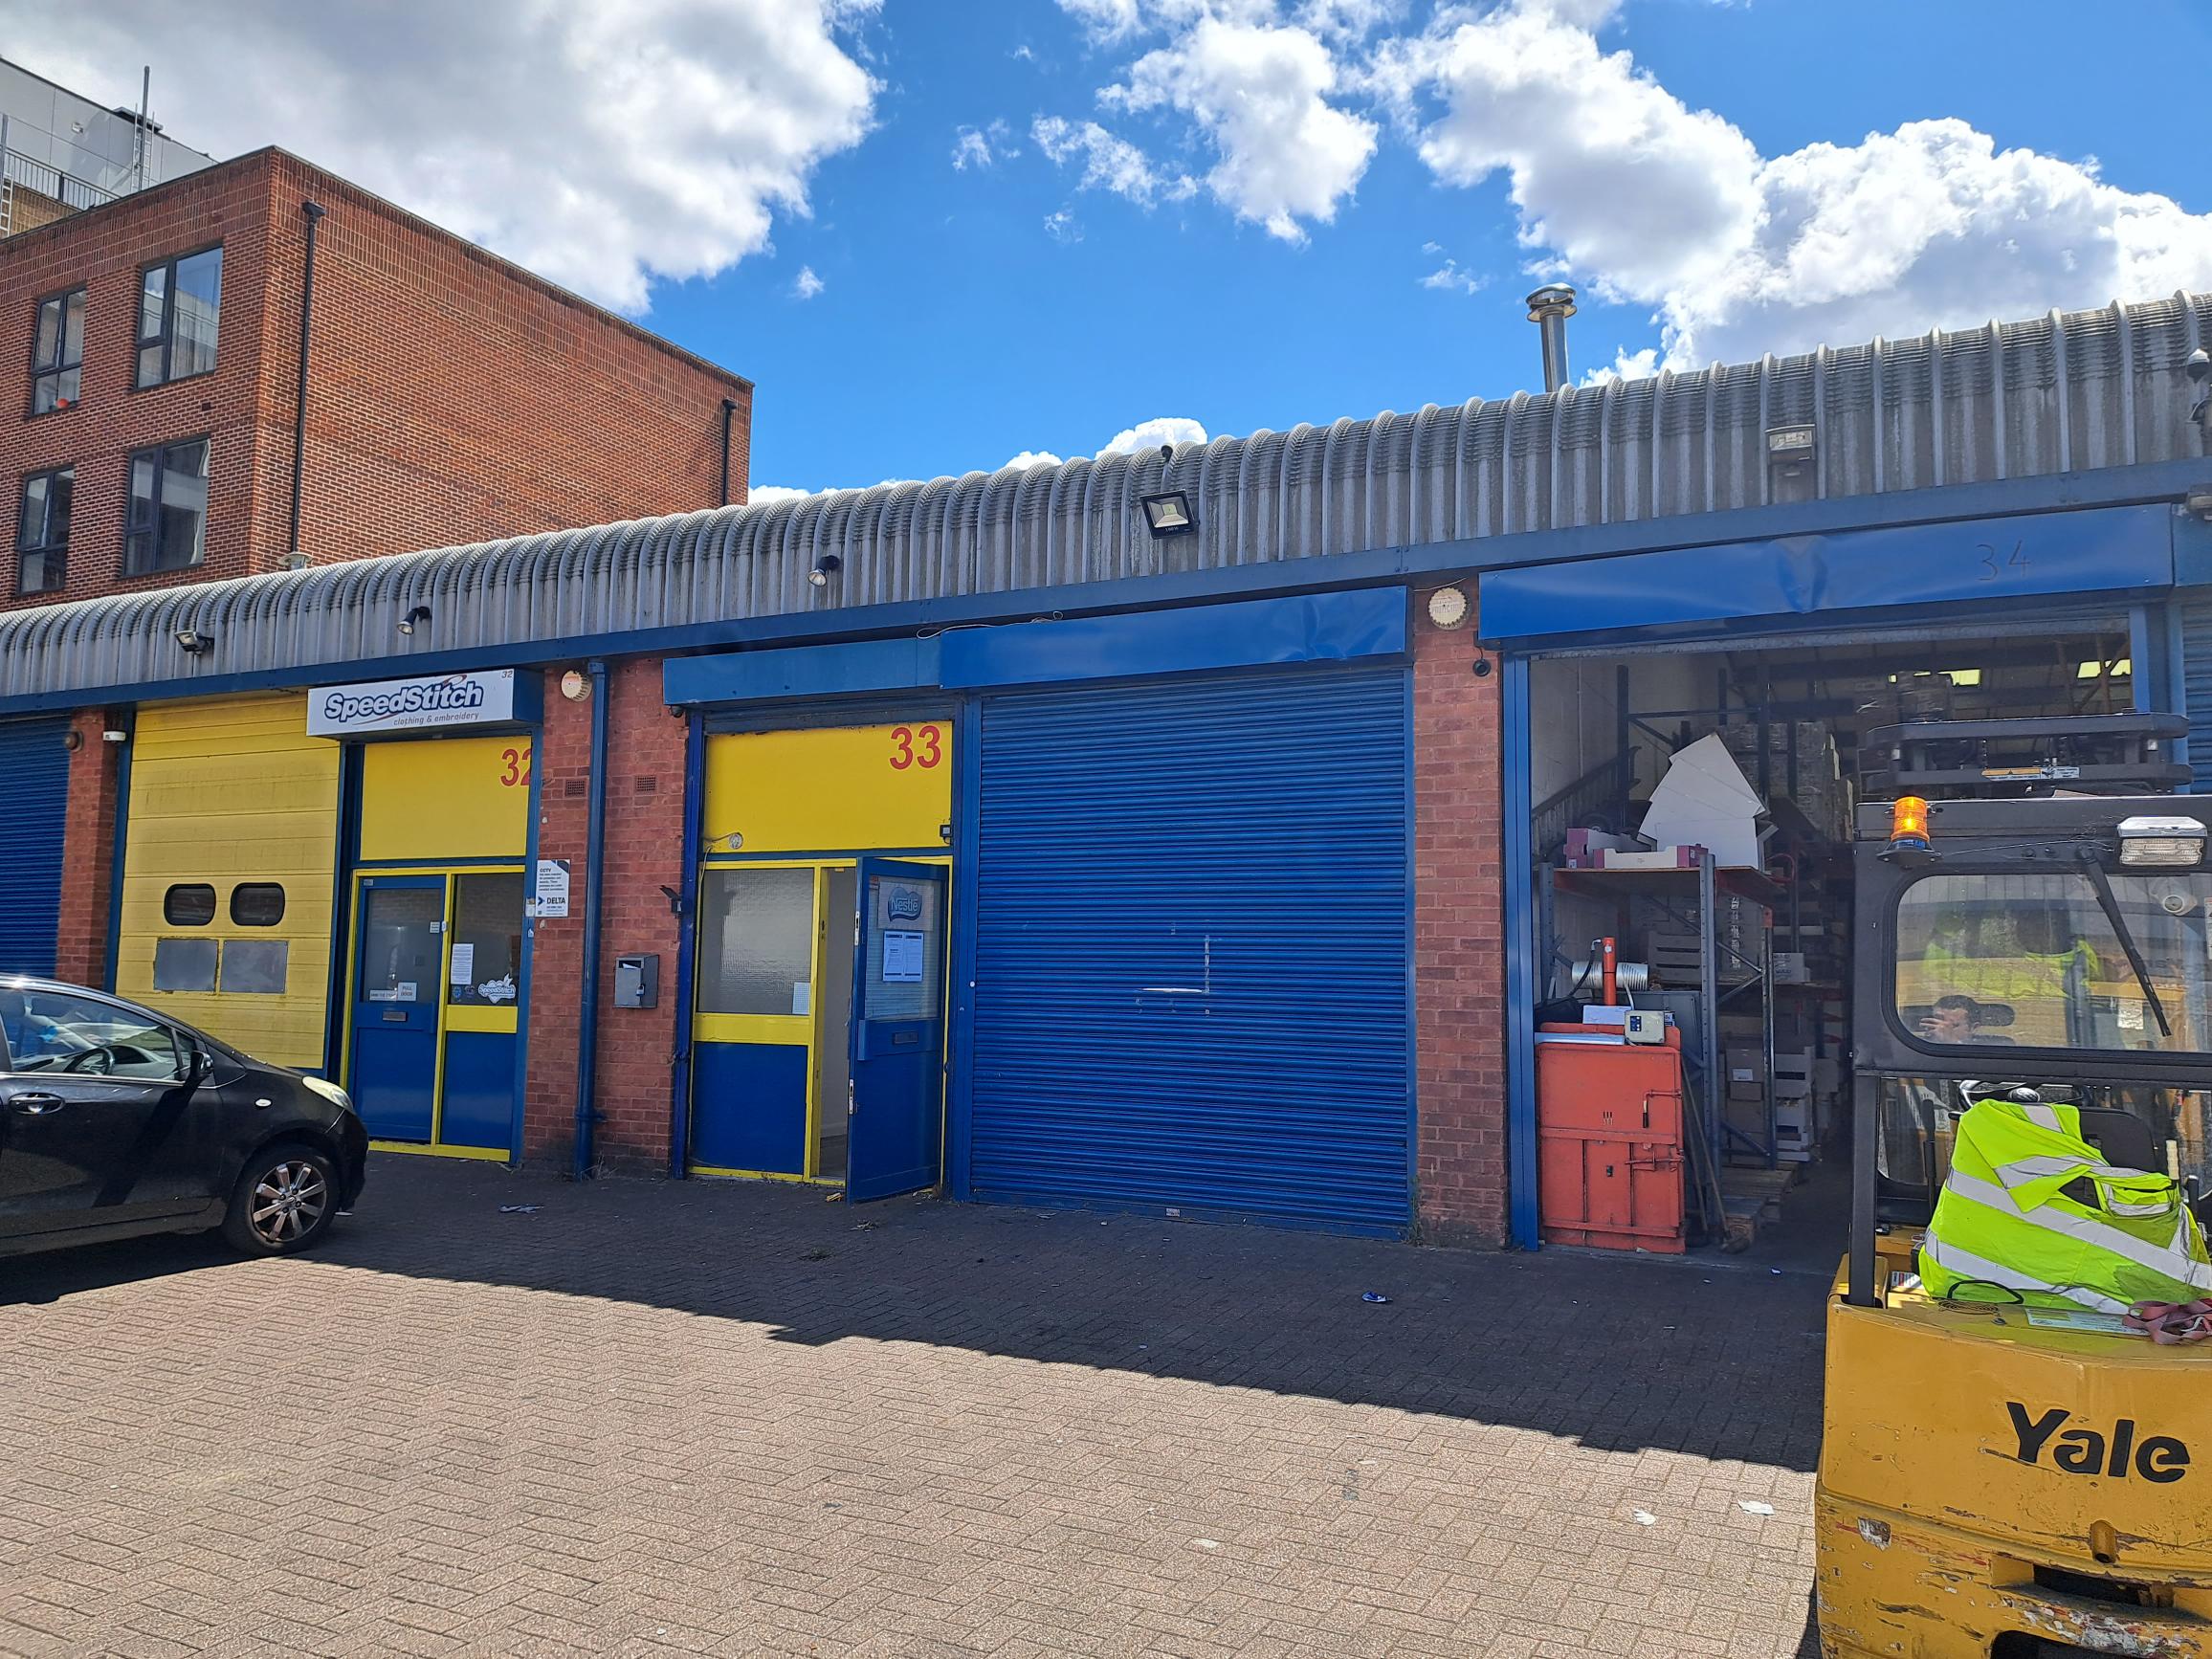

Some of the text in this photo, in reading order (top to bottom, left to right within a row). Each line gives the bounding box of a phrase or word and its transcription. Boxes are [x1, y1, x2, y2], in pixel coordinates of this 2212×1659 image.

[1976, 540, 2030, 581] 34
[324, 681, 484, 722] SpeedStitch
[393, 711, 479, 726] clothing & embroidery
[889, 725, 941, 769] 33
[546, 896, 566, 905] DELTA
[2006, 1402, 2190, 1483] Yale
